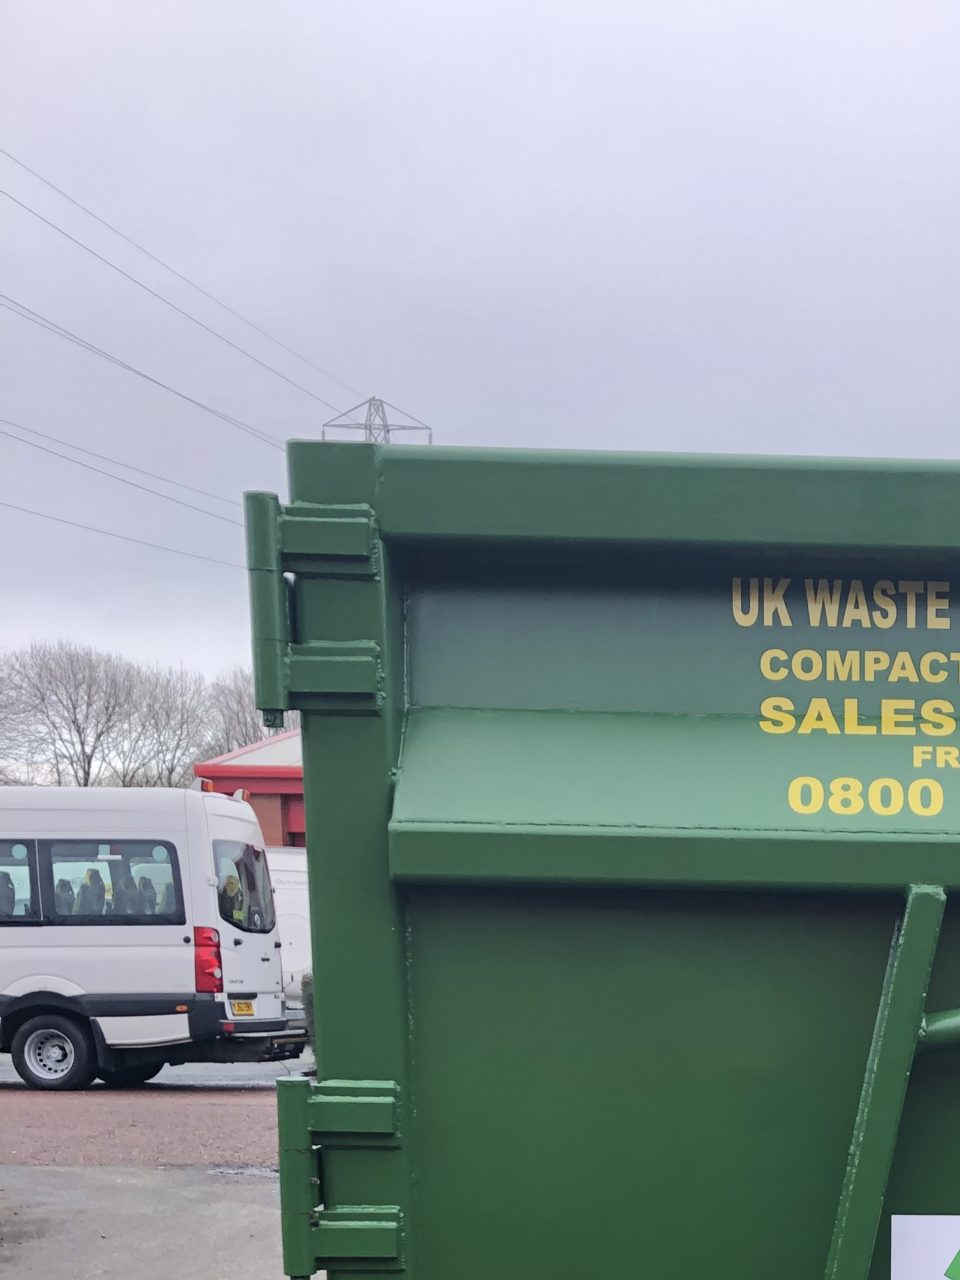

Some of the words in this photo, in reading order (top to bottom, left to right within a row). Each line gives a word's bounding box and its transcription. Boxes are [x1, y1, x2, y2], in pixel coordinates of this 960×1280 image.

[732, 577, 792, 627] UK
[804, 578, 951, 630] WASTE
[759, 696, 957, 737] SALES
[787, 776, 944, 817] 0800
